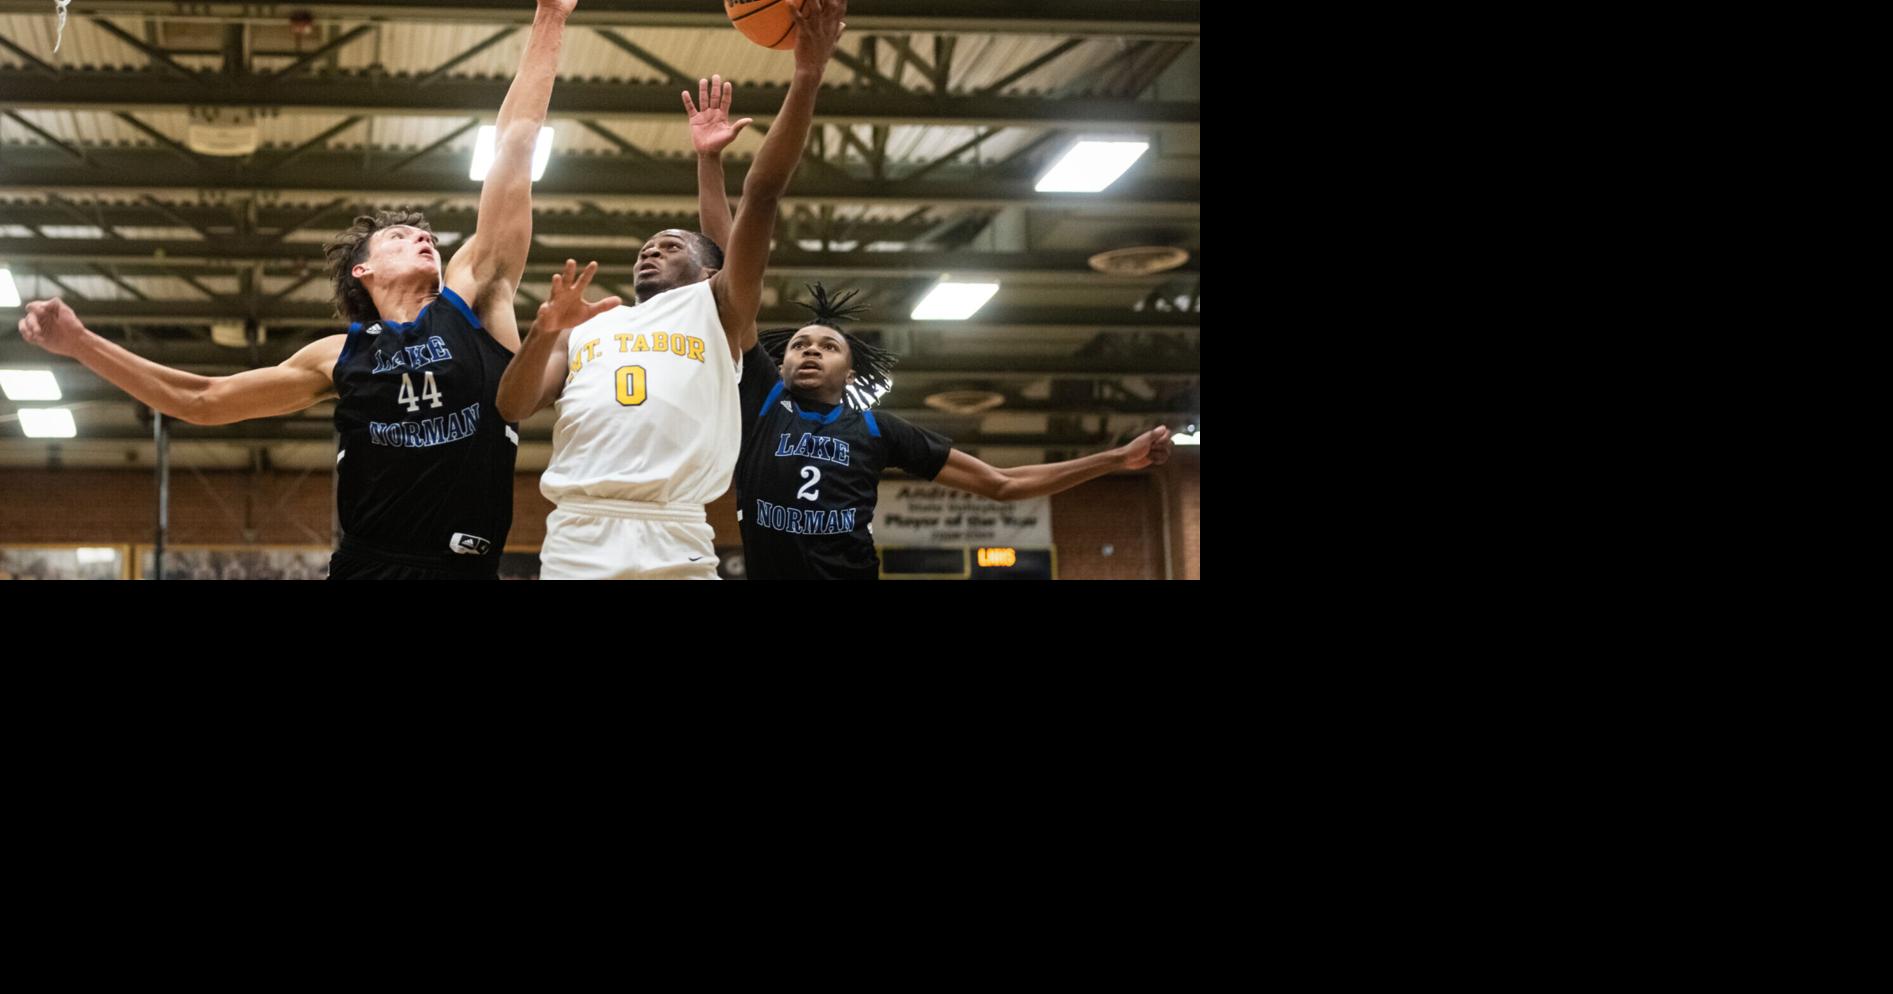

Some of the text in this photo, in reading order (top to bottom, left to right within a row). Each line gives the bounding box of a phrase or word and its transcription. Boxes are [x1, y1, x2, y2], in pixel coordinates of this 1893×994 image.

[372, 336, 452, 374] LAKE
[614, 331, 705, 363] TABOR
[398, 371, 443, 412] 44
[615, 365, 647, 407] 0
[369, 403, 481, 447] NORMAN
[774, 433, 850, 466] LAKE
[796, 465, 821, 501] 2
[756, 499, 857, 534] NORMAN
